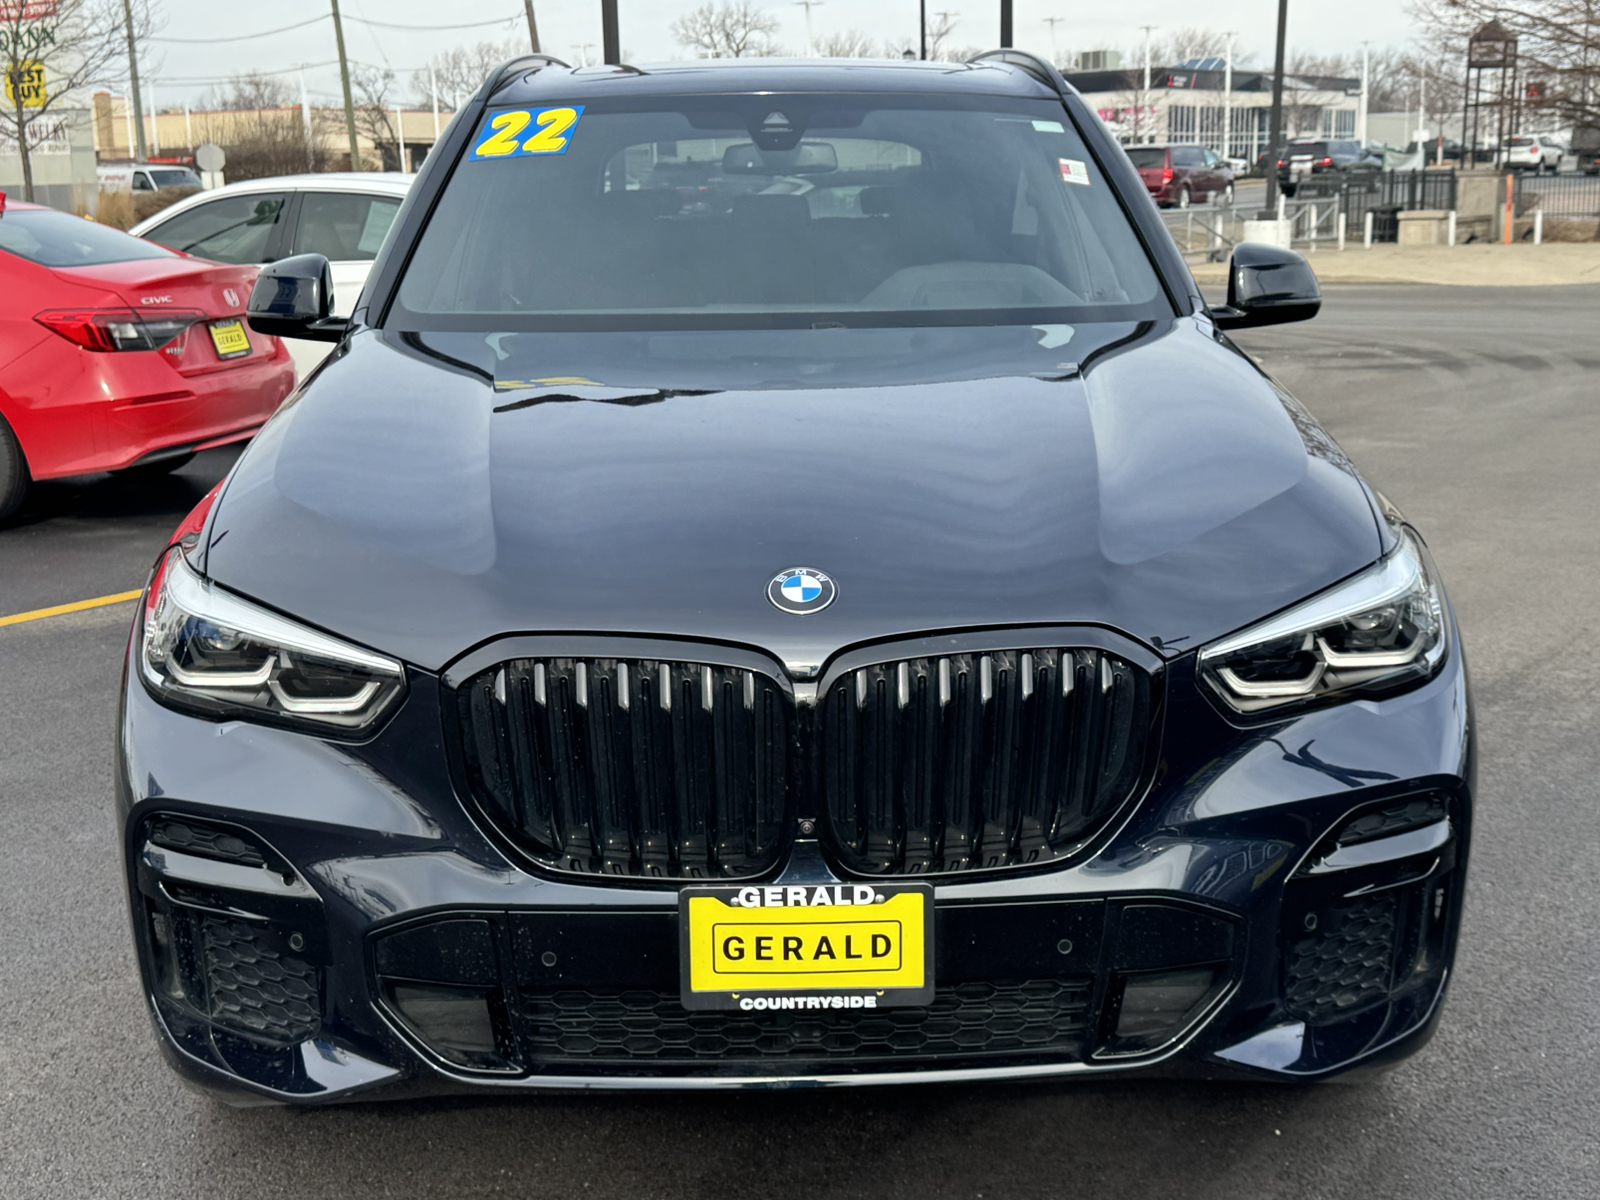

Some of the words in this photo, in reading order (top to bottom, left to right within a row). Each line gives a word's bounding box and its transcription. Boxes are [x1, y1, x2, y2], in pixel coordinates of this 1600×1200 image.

[475, 107, 578, 158] 22
[141, 295, 173, 304] CIVIC
[217, 333, 243, 346] GERALD
[775, 569, 828, 583] BMW
[737, 885, 876, 908] GERALD
[722, 934, 892, 961] GERALD
[739, 996, 877, 1011] COUNTRYSIDE
